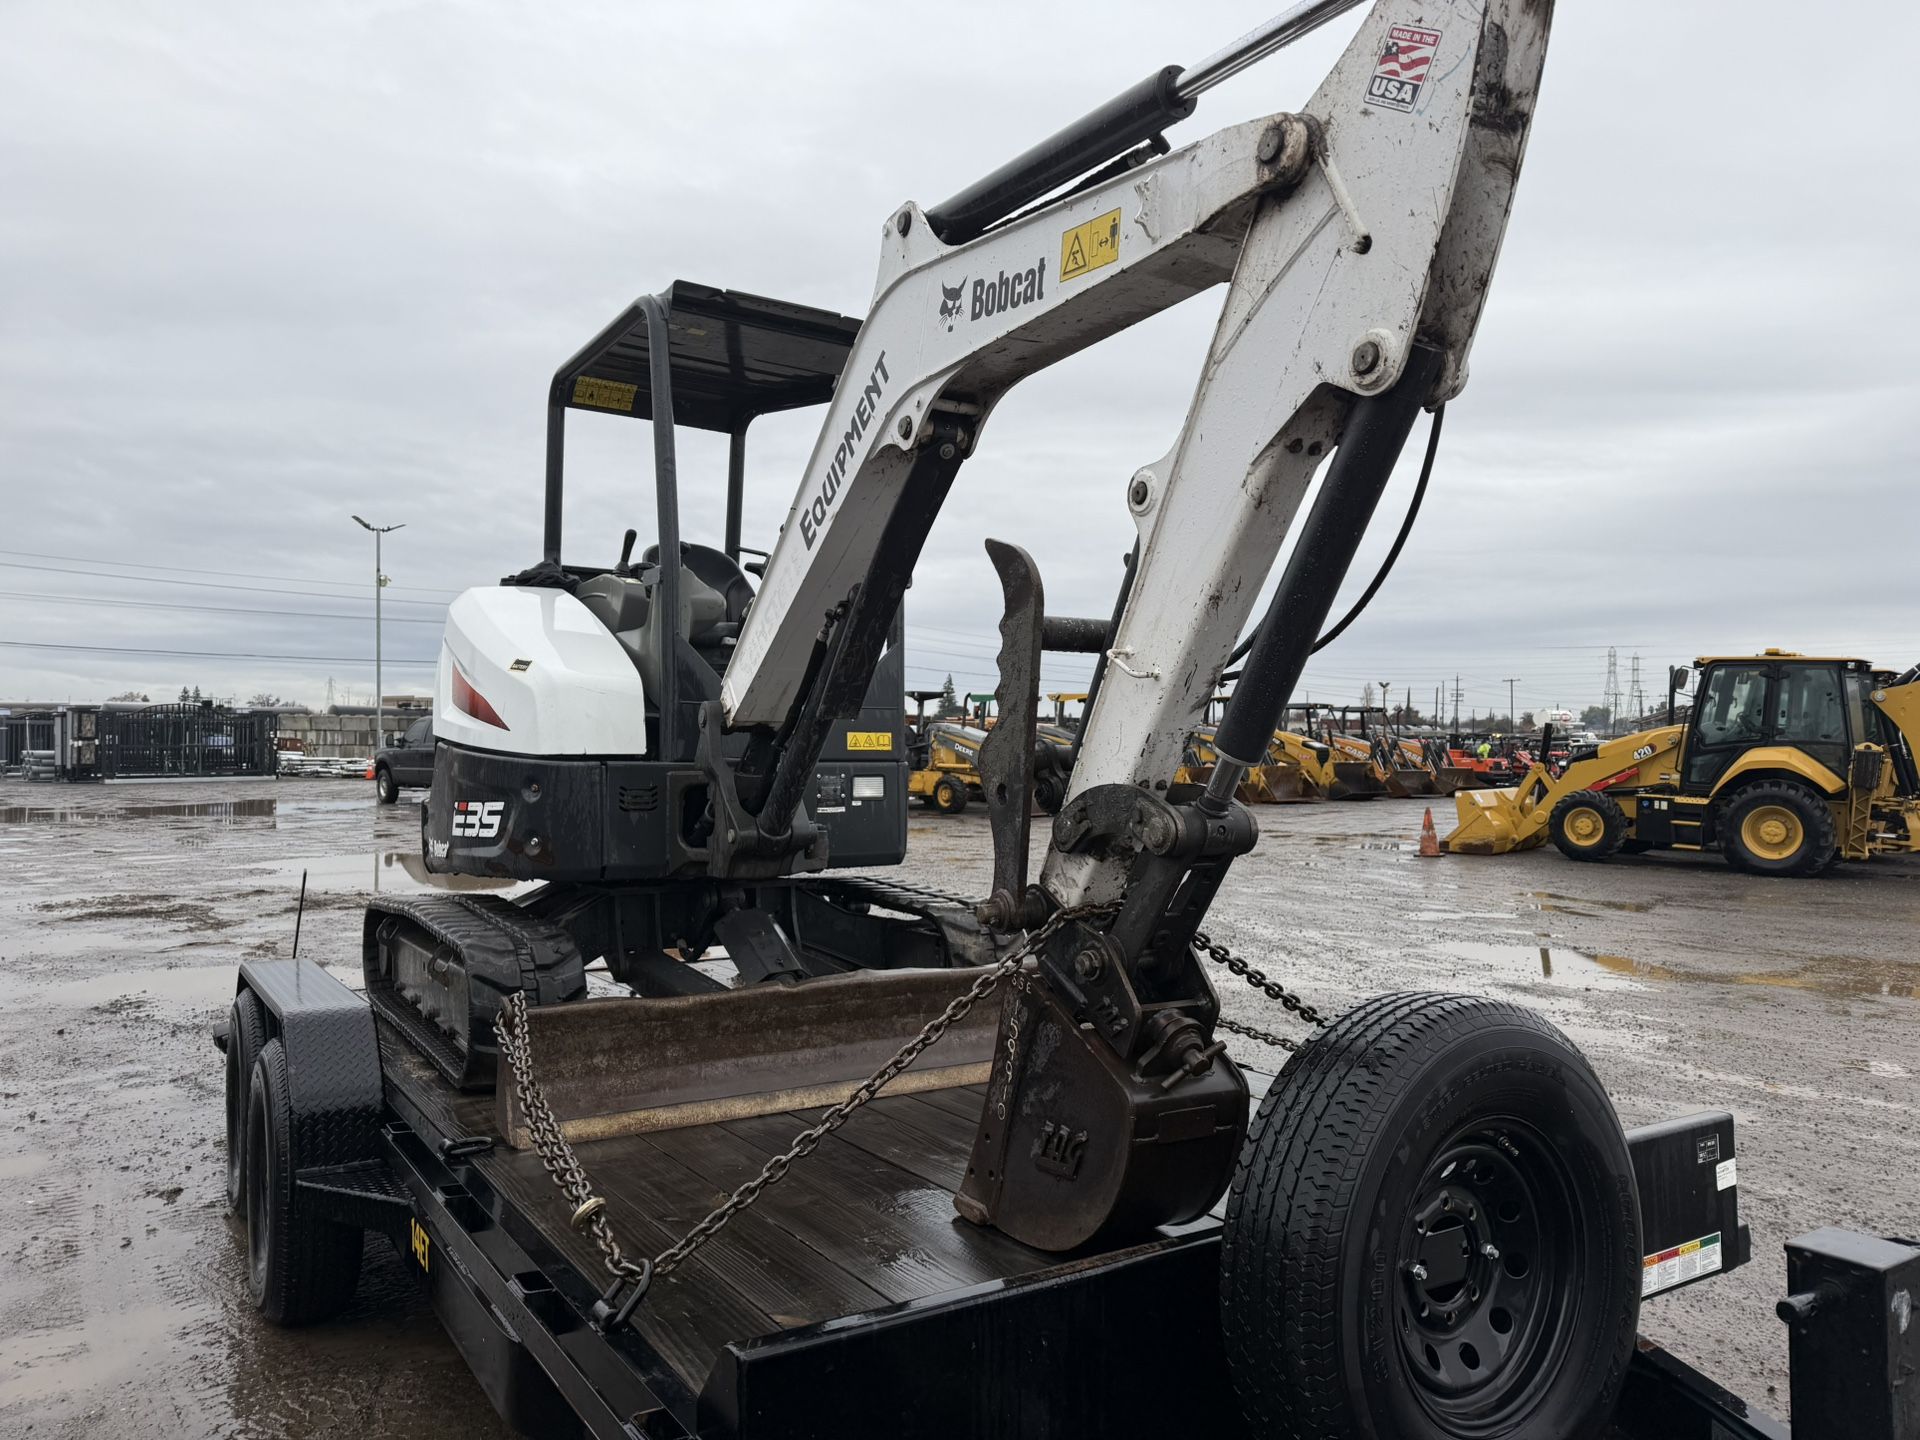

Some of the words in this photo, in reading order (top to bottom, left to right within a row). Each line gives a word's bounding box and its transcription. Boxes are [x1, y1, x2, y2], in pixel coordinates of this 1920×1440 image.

[1391, 29, 1412, 40] MADE
[1412, 33, 1421, 42] IN
[1422, 35, 1437, 45] THE
[1371, 78, 1414, 103] USA
[970, 257, 1046, 322] Bobcat
[799, 350, 890, 551] EQUIPMENT
[954, 742, 974, 757] DEERE
[1633, 745, 1653, 760] 420
[452, 802, 505, 837] E35
